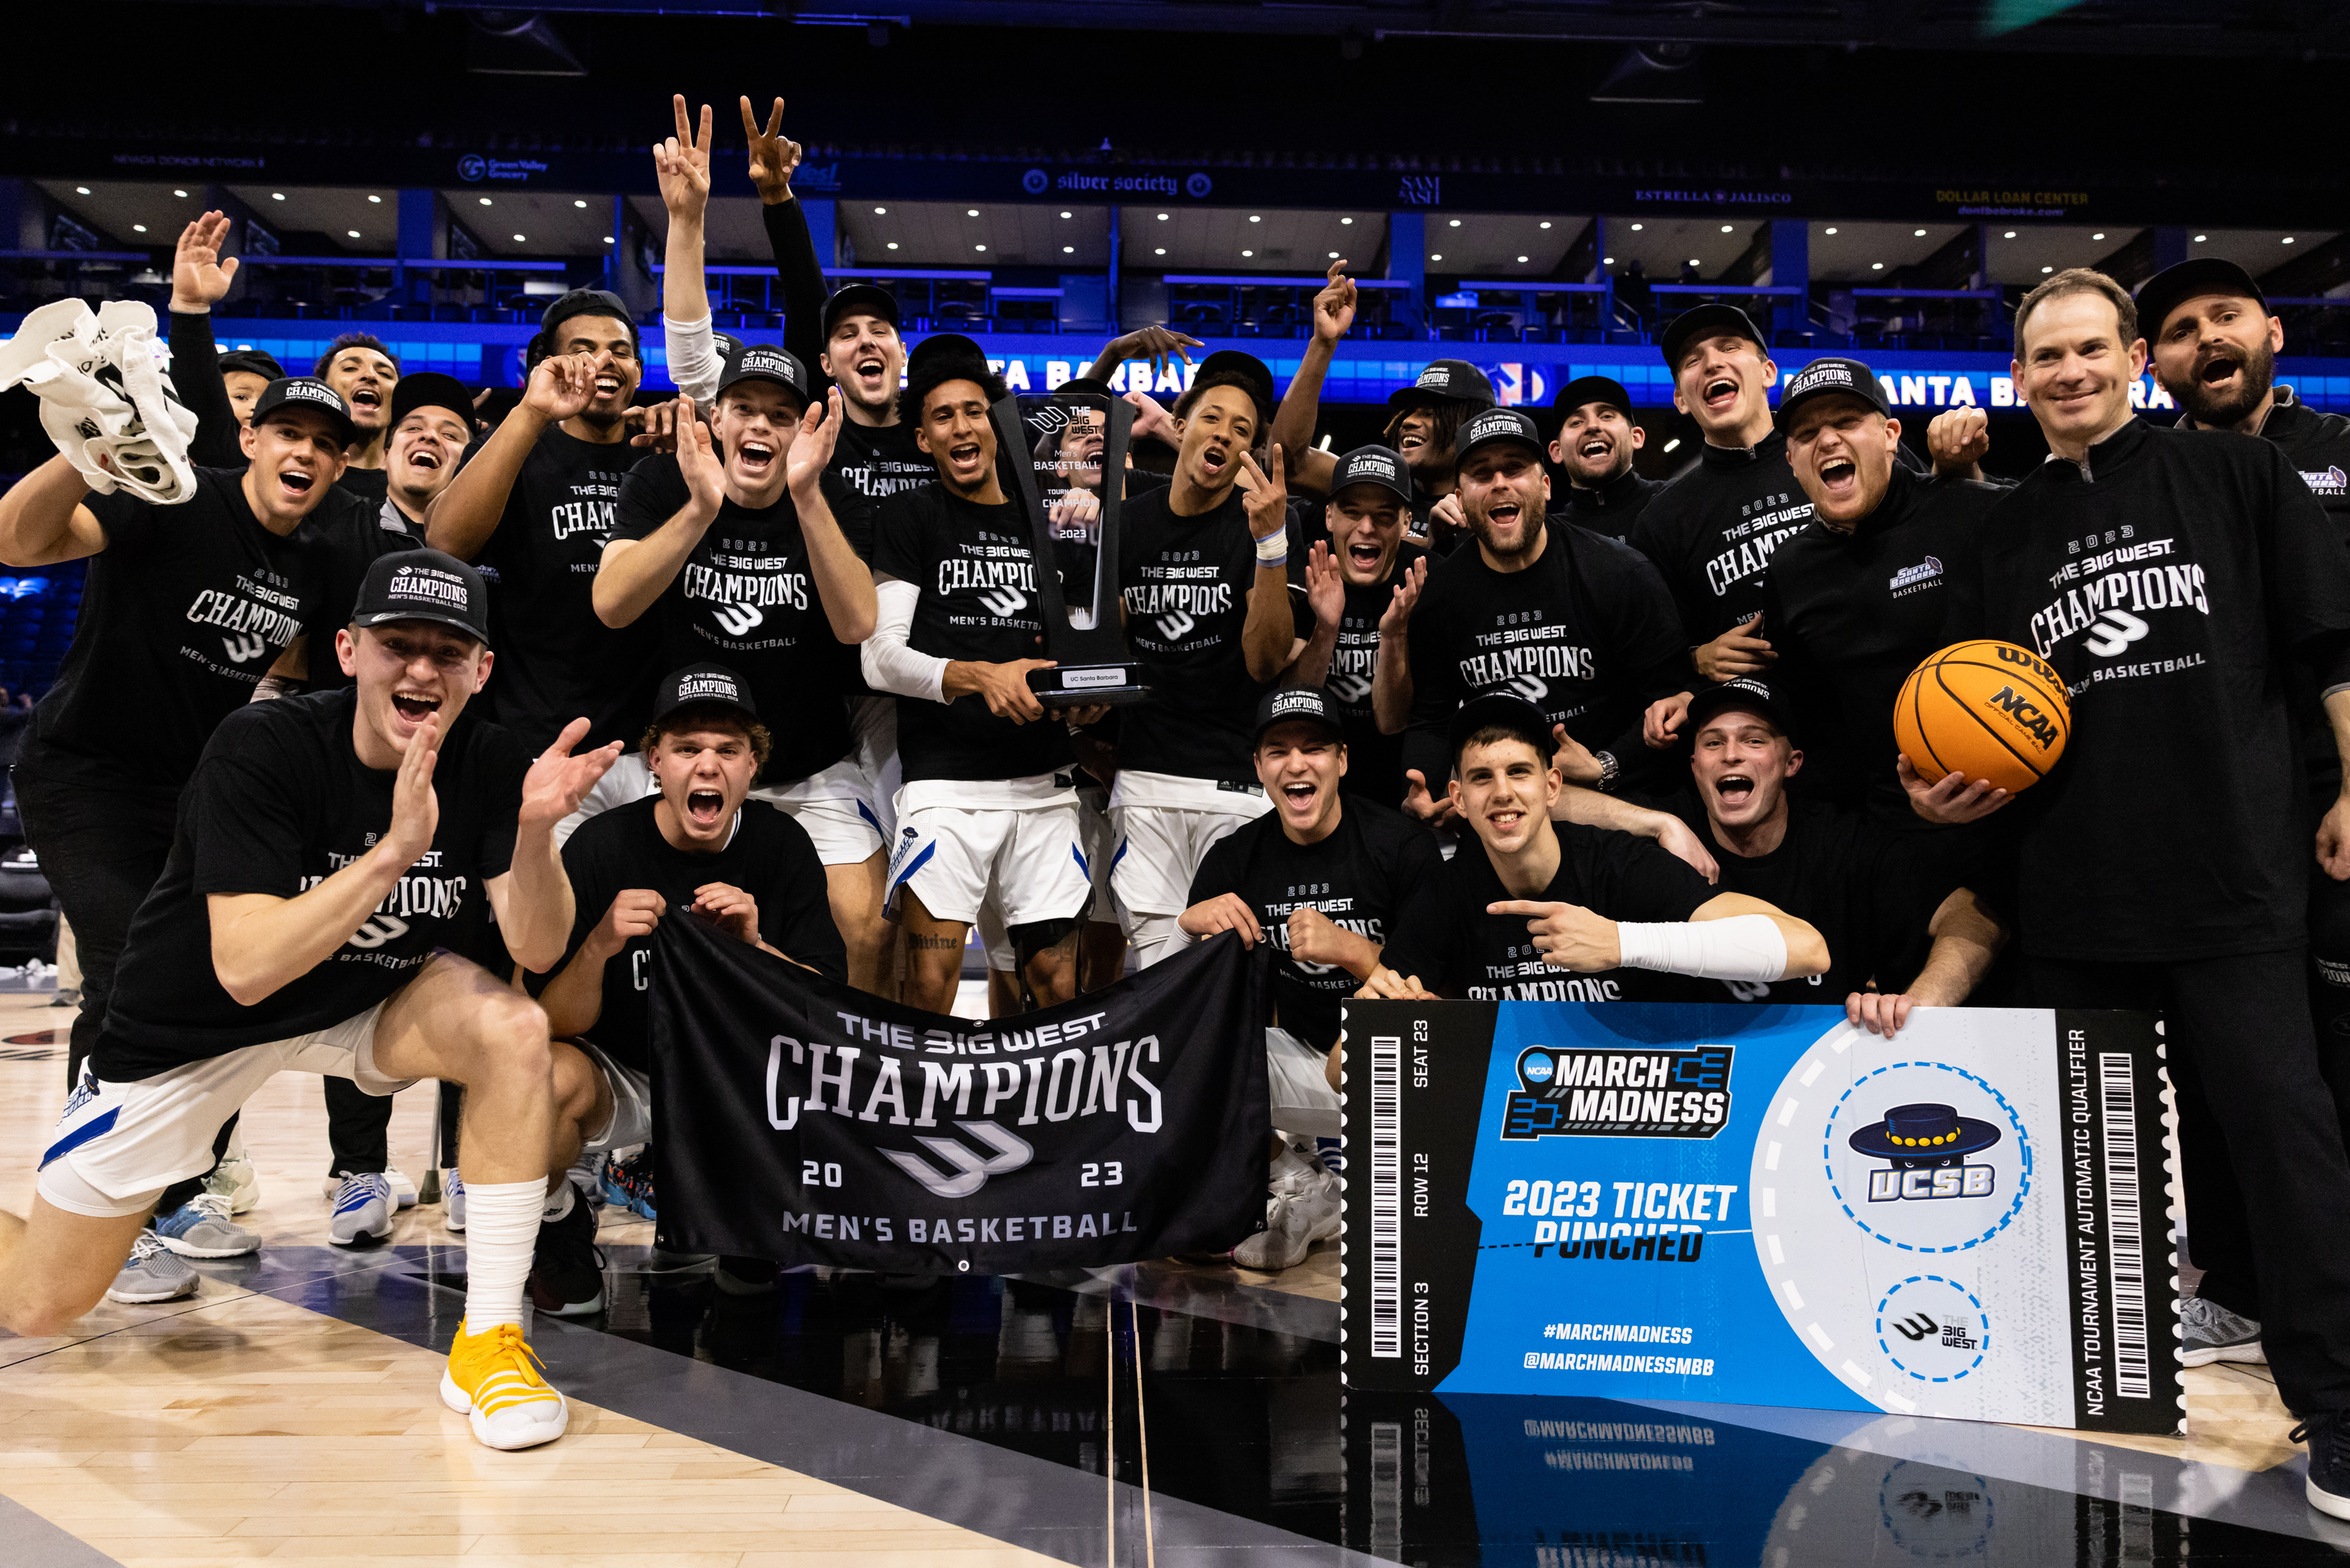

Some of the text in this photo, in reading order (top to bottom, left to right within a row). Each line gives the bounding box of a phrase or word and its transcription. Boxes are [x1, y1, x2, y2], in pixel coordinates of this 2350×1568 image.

[1057, 171, 1178, 196] silver society
[1635, 190, 1792, 203] ESTRELLA JALISCO
[1936, 189, 2089, 205] DOLLAR LOAN CENTER
[741, 356, 794, 379] CHAMPIONS
[1791, 369, 1852, 397] CHAMPIONS
[1885, 375, 1980, 404] ANTA
[286, 386, 342, 411] CHAMPIONS
[1069, 406, 1091, 416] THE
[1071, 415, 1090, 425] BIG
[1071, 425, 1099, 434] WEST
[1470, 421, 1523, 440] CHAMPIONS
[1054, 449, 1078, 458] Men's
[880, 461, 902, 473] BIG
[1033, 461, 1100, 470] BASKETBALL
[1347, 460, 1396, 477] CHAMPIONS
[570, 484, 597, 496] THE
[1742, 493, 1789, 516] 2023
[1059, 529, 1087, 538] 2023
[1722, 522, 1751, 542] THE
[1751, 511, 1777, 532] BIG
[722, 538, 768, 552] 2023
[2068, 524, 2134, 554] 2023
[959, 543, 1010, 558] THE BIG
[1161, 550, 1200, 562] 2023
[414, 567, 429, 576] THE
[728, 555, 753, 570] BIG
[753, 556, 788, 570] WEST
[1140, 566, 1219, 579] THE BIG WEST
[1897, 562, 1931, 579] SANTA
[2049, 538, 2174, 589] THE BIG WEST
[235, 574, 256, 595] THE
[684, 562, 808, 610] CHAMPIONS
[1890, 568, 1936, 589] BARBARA
[1892, 578, 1943, 599] BASKETBALL
[390, 576, 467, 605] CHAMPIONS
[388, 593, 468, 612] MEN'S BASKETBALL 2023
[2031, 563, 2209, 660] CHAMPIONS
[186, 589, 303, 648] CHAMPION
[949, 615, 986, 626] MEN'S
[1496, 610, 1543, 626] 2023
[693, 622, 797, 650] MEN'S BASKETBALL
[1158, 634, 1222, 653] BASKETBALL
[1475, 625, 1566, 647] THE BIG WEST
[180, 645, 218, 673] MEN'S
[1459, 646, 1595, 689] CHAMPIONS
[2093, 652, 2206, 683] BASKETBALL
[678, 680, 738, 697] CHAMPIONS
[1271, 697, 1324, 714] CHAMPIONS
[1989, 684, 2060, 750] NCAA
[1984, 701, 2042, 756] OFFICIAL GAME BALL
[1287, 883, 1330, 896] 2023
[1265, 902, 1292, 916] THE
[1316, 897, 1353, 913] WEST
[1486, 963, 1515, 979] THE
[1516, 961, 1545, 976] BIG
[836, 1010, 1107, 1056] THE BIG WEST
[1412, 1020, 1429, 1089] SEAT 23
[1526, 1066, 1553, 1076] NCAA
[1555, 1054, 1670, 1088] MARCH
[765, 1033, 1163, 1134] CHAMPIONS
[1568, 1089, 1725, 1124] MADNESS
[802, 1159, 1124, 1188] 20 23
[1869, 1165, 1994, 1202] UCSB
[1413, 1153, 1429, 1217] ROW 12
[1502, 1178, 1738, 1222] 2023 TICKET
[782, 1210, 1139, 1244] MEN'S BASKETBALL
[2067, 1028, 2105, 1416] NCAA TOURNAMENT AUTOMATIC QUALIFIER
[1533, 1219, 1704, 1263] PUNCHED
[1413, 1282, 1430, 1375] SECTION 3
[1942, 1314, 1969, 1327] THE
[1942, 1325, 1966, 1337] BIG
[1543, 1322, 1693, 1345] #MARCHMADNESS
[1942, 1336, 1977, 1350] WEST
[1523, 1350, 1715, 1377] @MARCHMADNESSMBB
